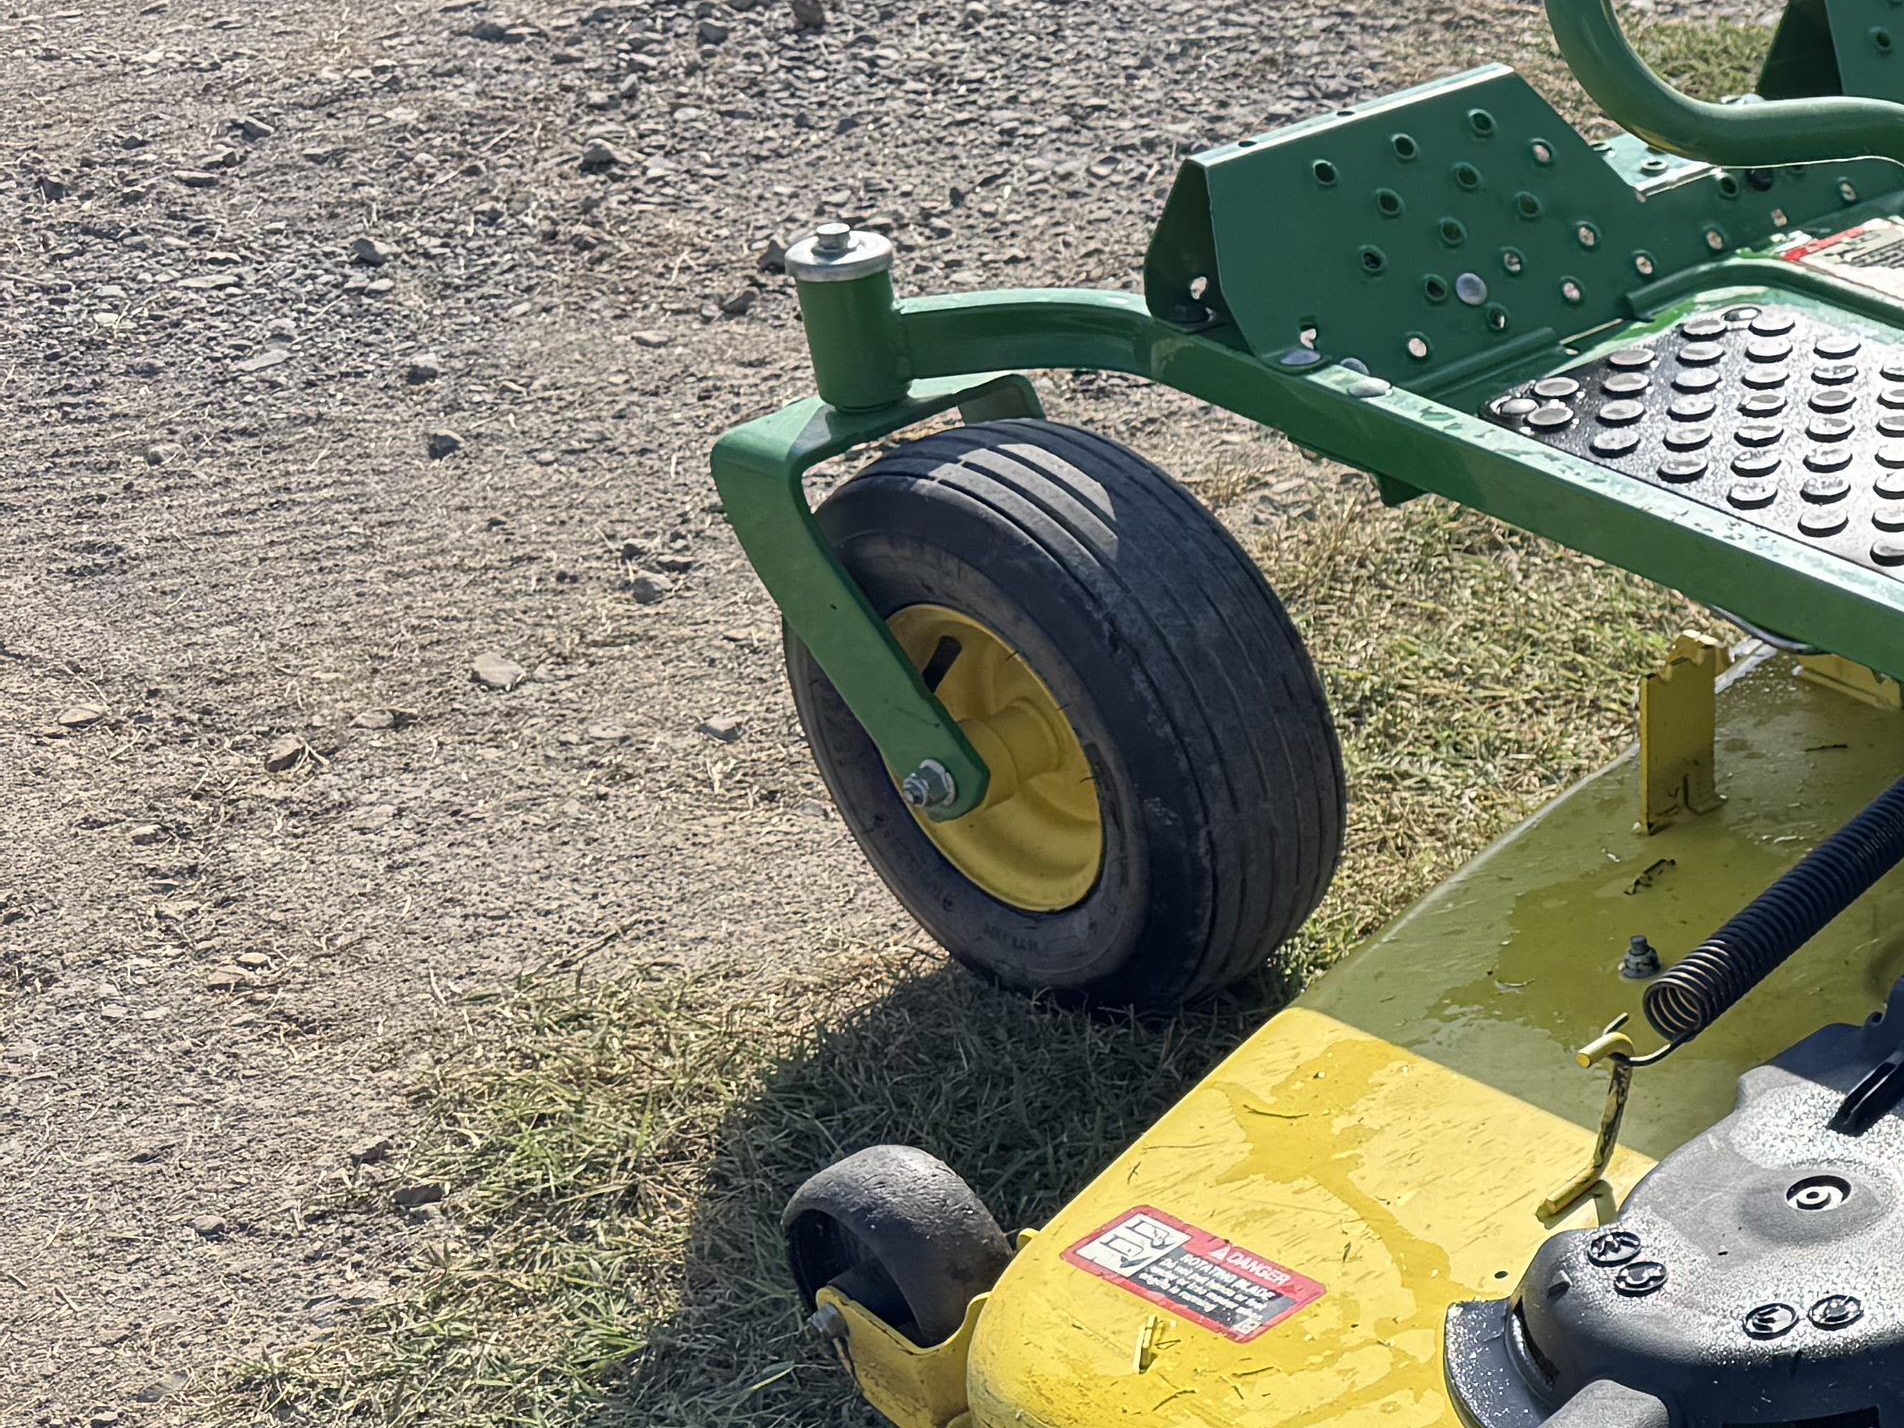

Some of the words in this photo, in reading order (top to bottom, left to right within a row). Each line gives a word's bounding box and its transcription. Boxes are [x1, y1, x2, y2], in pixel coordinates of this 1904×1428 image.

[1180, 1254, 1238, 1284] ROTATING
[1231, 1277, 1276, 1301] BLADE
[1226, 1252, 1291, 1286] DANGER
